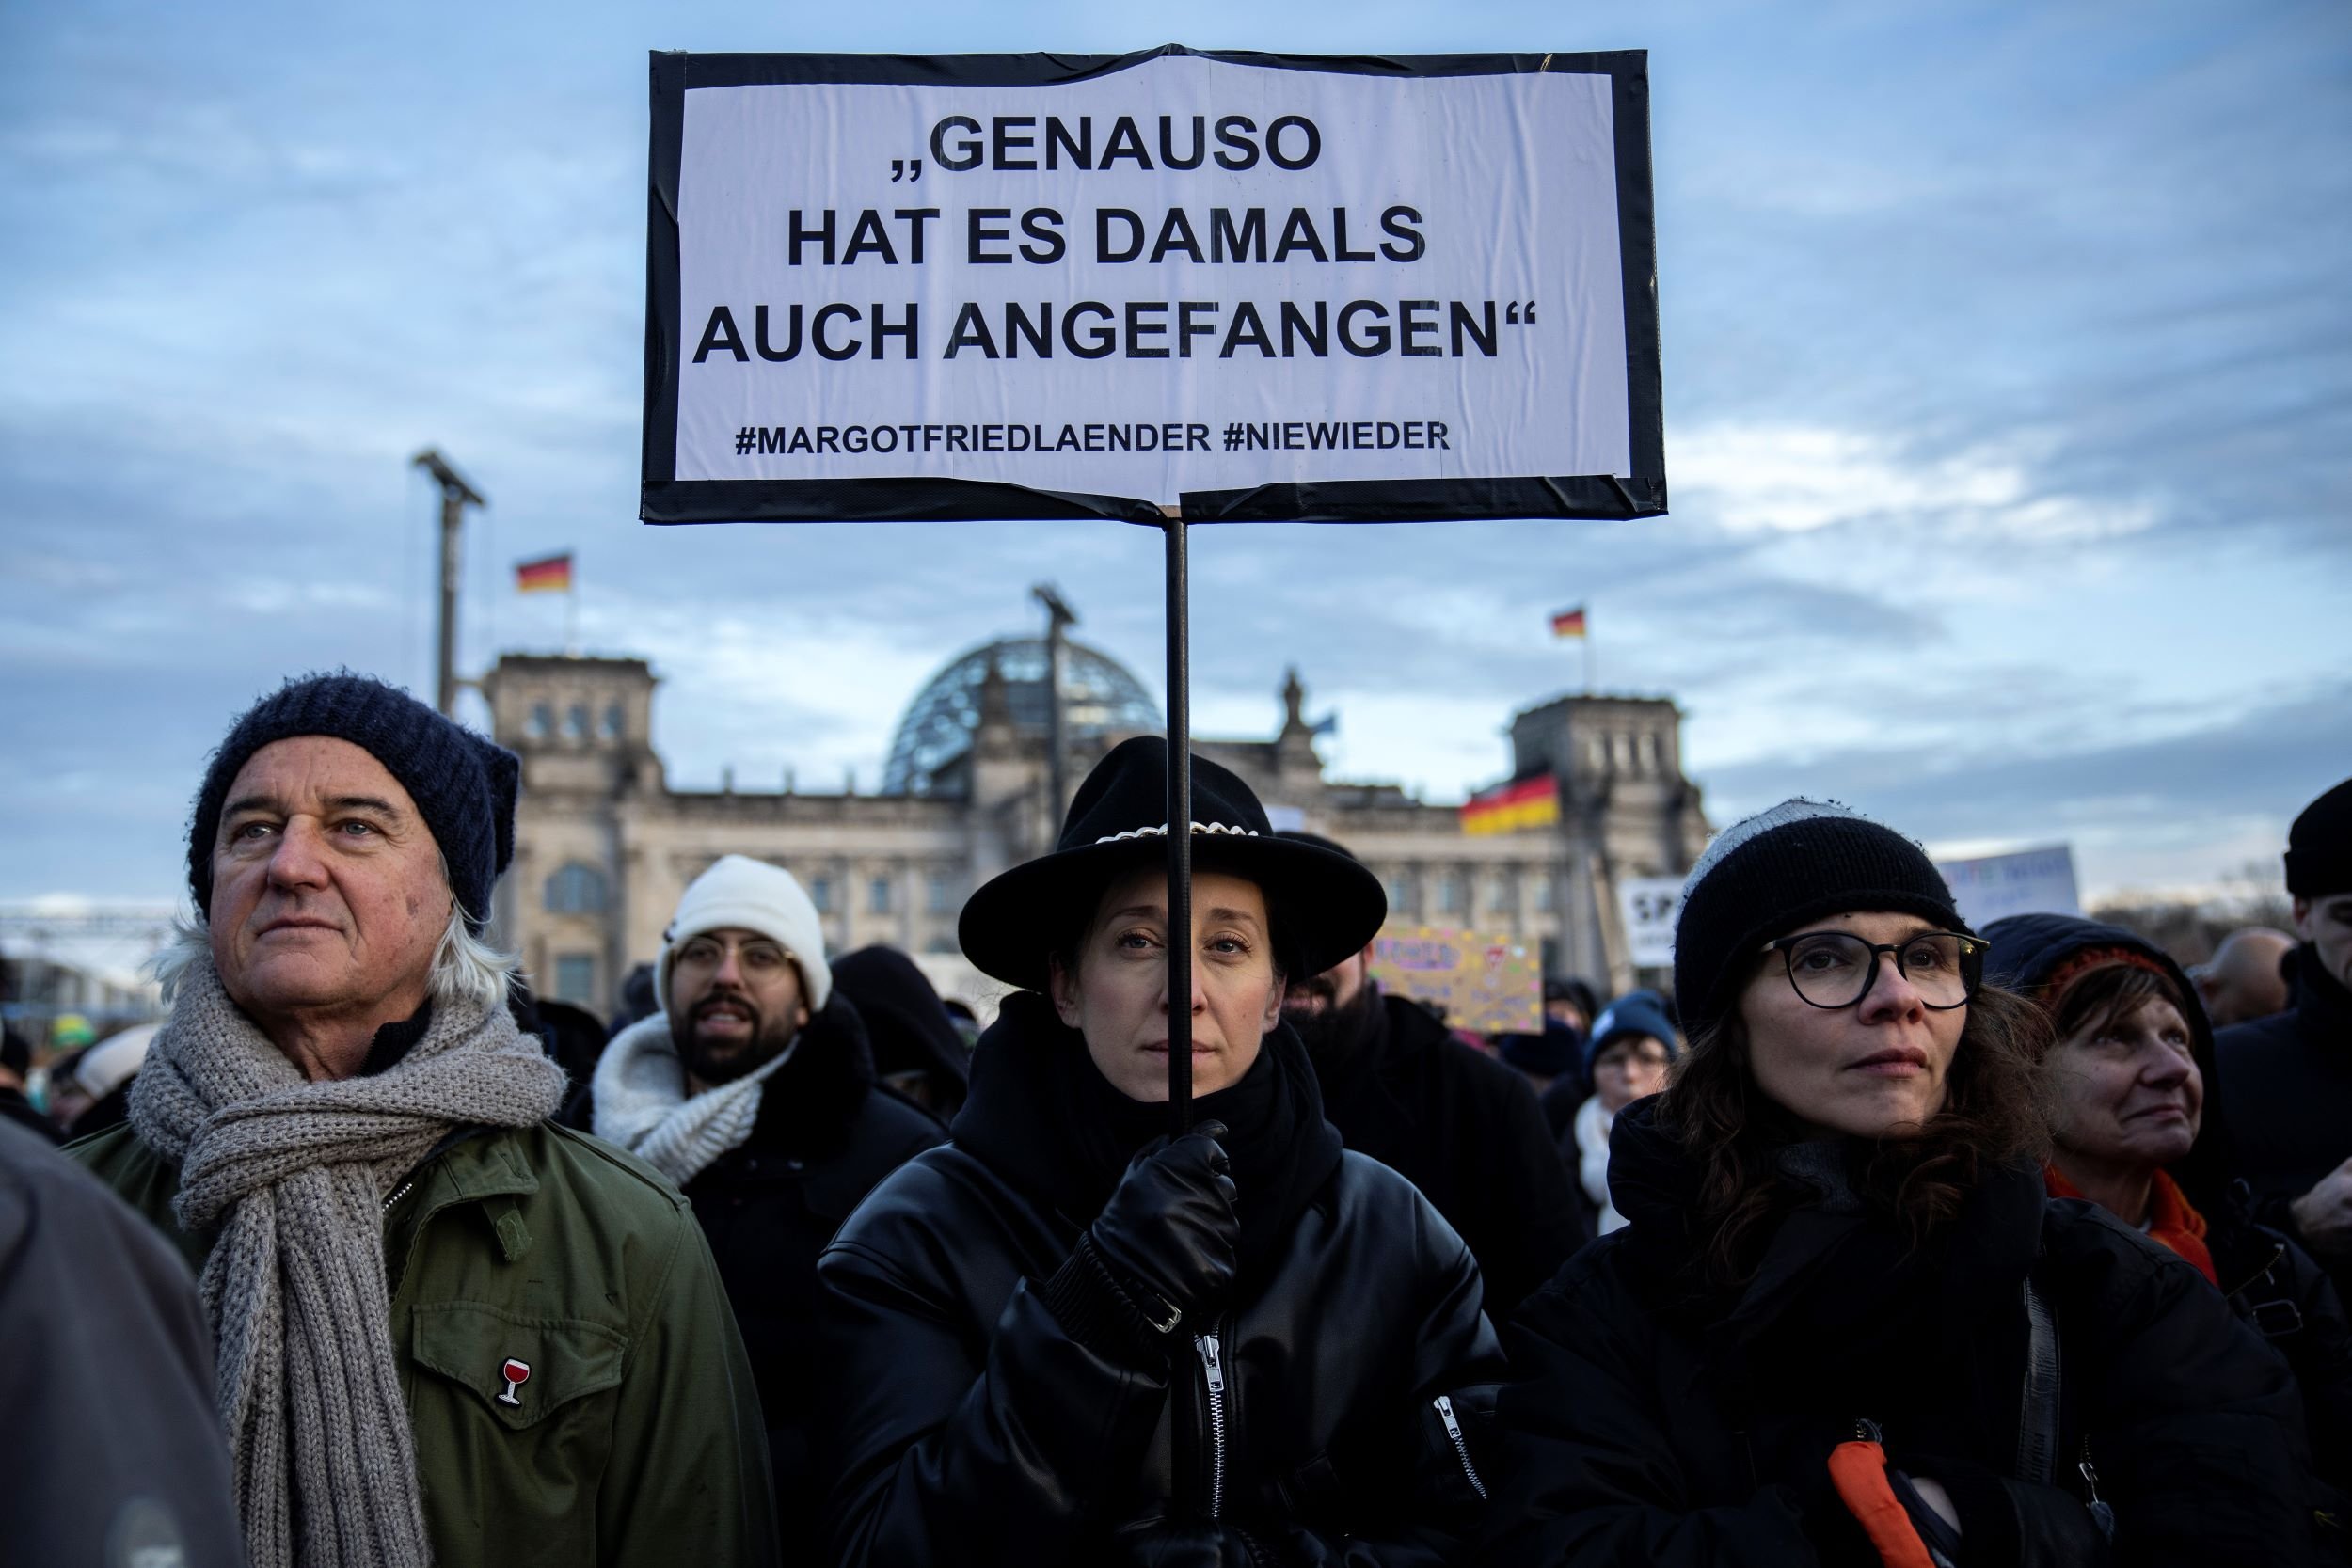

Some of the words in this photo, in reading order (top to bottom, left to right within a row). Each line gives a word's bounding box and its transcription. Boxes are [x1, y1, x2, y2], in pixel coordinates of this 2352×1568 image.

[890, 115, 1322, 183] „GENAUSO
[788, 209, 941, 266] HAT
[967, 207, 1067, 265] ES
[1095, 205, 1426, 264] DAMALS
[691, 302, 919, 364] AUCH
[942, 299, 1537, 360] ANGEFANGEN“
[735, 423, 1212, 456] #MARGOTFRIEDLAENDER
[1222, 420, 1452, 451] #NIEWIEDER
